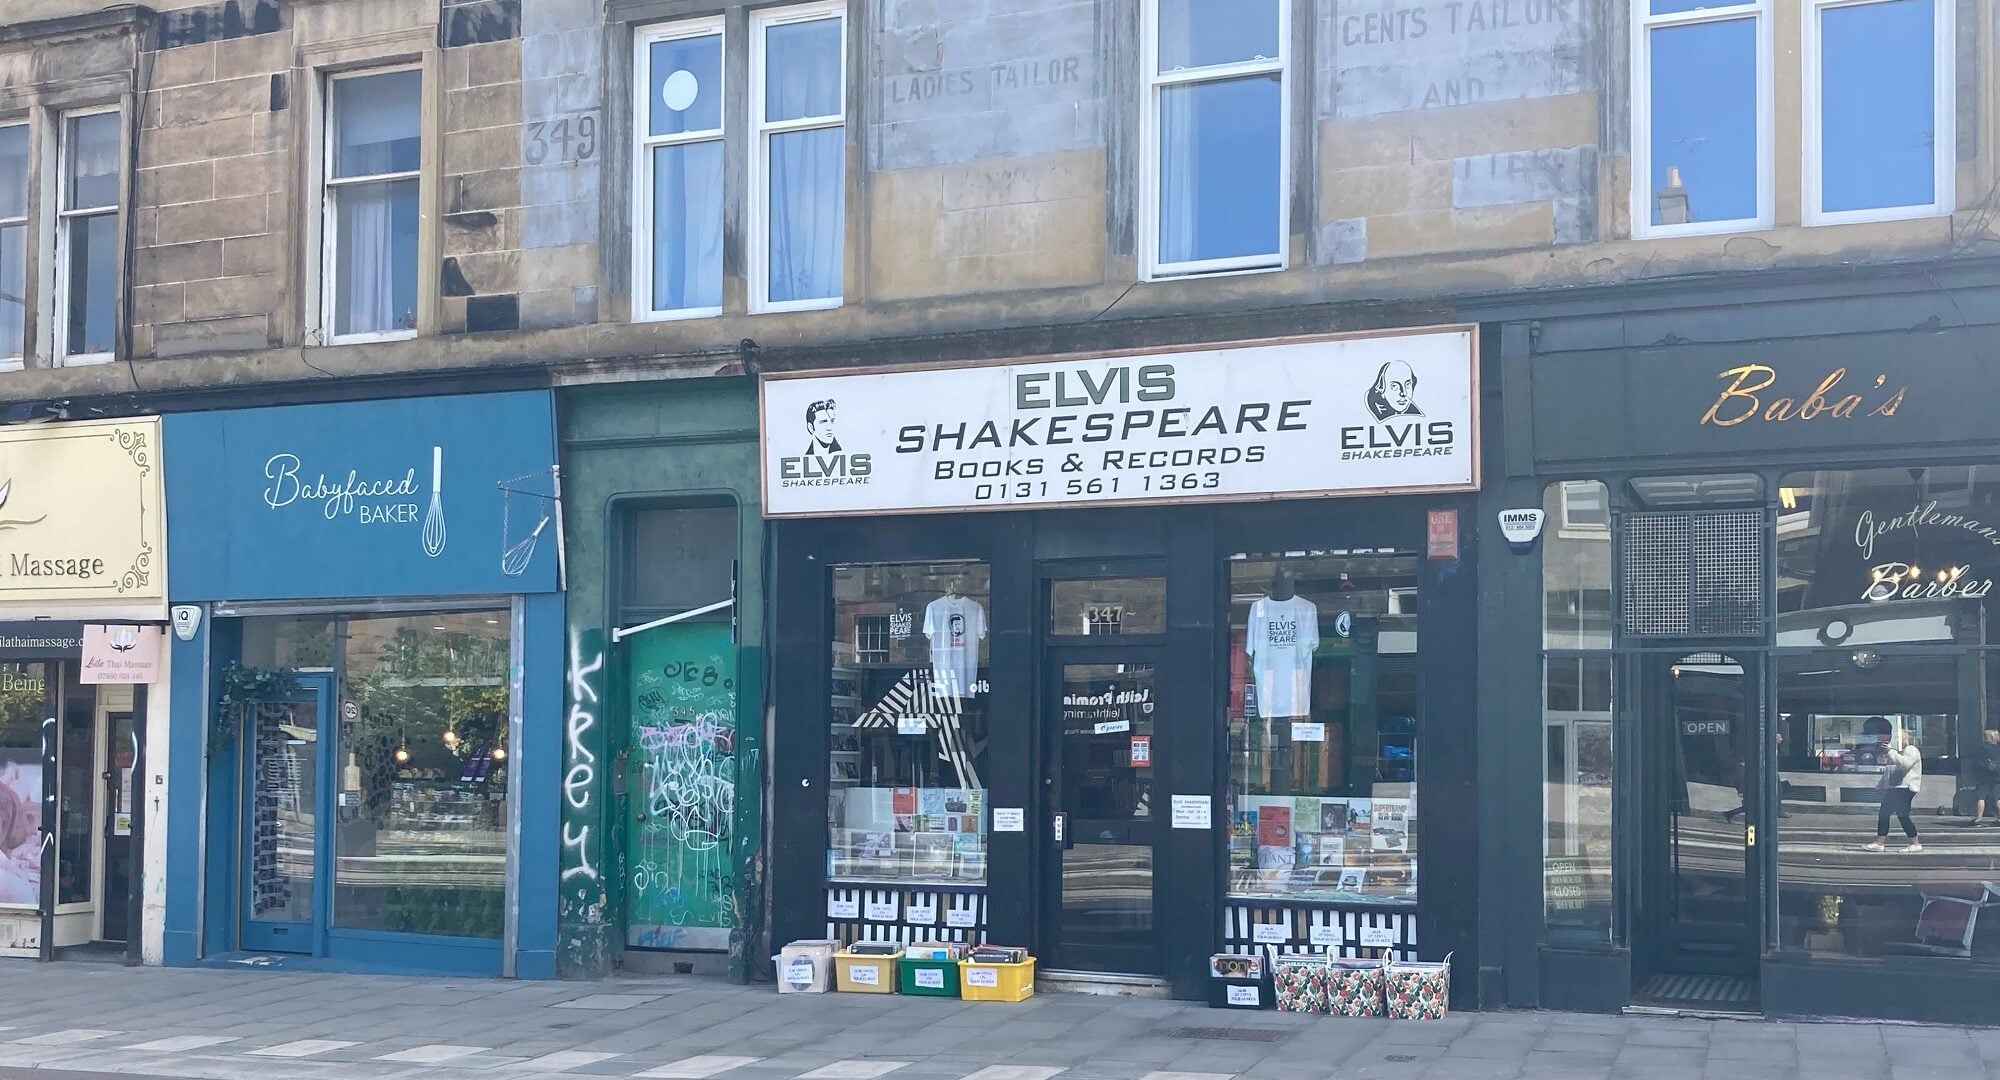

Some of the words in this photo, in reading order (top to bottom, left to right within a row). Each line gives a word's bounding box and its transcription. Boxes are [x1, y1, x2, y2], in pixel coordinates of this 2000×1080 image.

[1342, 6, 1428, 47] GENTS
[890, 68, 975, 105] LADIES
[991, 55, 1081, 86] TAILOR
[1422, 76, 1486, 108] AND
[523, 115, 597, 166] 349
[1016, 364, 1176, 410] ELVIS
[1699, 363, 1909, 427] Baba's
[895, 399, 1313, 454] SHAKESPEARE
[1340, 420, 1454, 450] ELVIS
[779, 452, 873, 480] ELVIS
[1060, 453, 1084, 474] &
[1340, 445, 1454, 461] SHAKESPEARE
[263, 452, 419, 520] Babyfaced
[780, 474, 871, 489] SHAKESPEARE
[974, 480, 1049, 502] 0131
[1065, 475, 1121, 496] 561
[1142, 471, 1222, 491] 1363
[359, 502, 419, 524] BAKER
[1503, 513, 1537, 523] IMMS
[10, 553, 105, 579] Massage
[1860, 561, 1993, 601] Barber
[889, 613, 912, 623] ELVIS
[1269, 621, 1296, 630] ELVIS
[2, 673, 45, 694] Being
[1687, 721, 1726, 735] OPEN
[1552, 862, 1576, 873] OPEN
[1554, 886, 1582, 897] CLOSED
